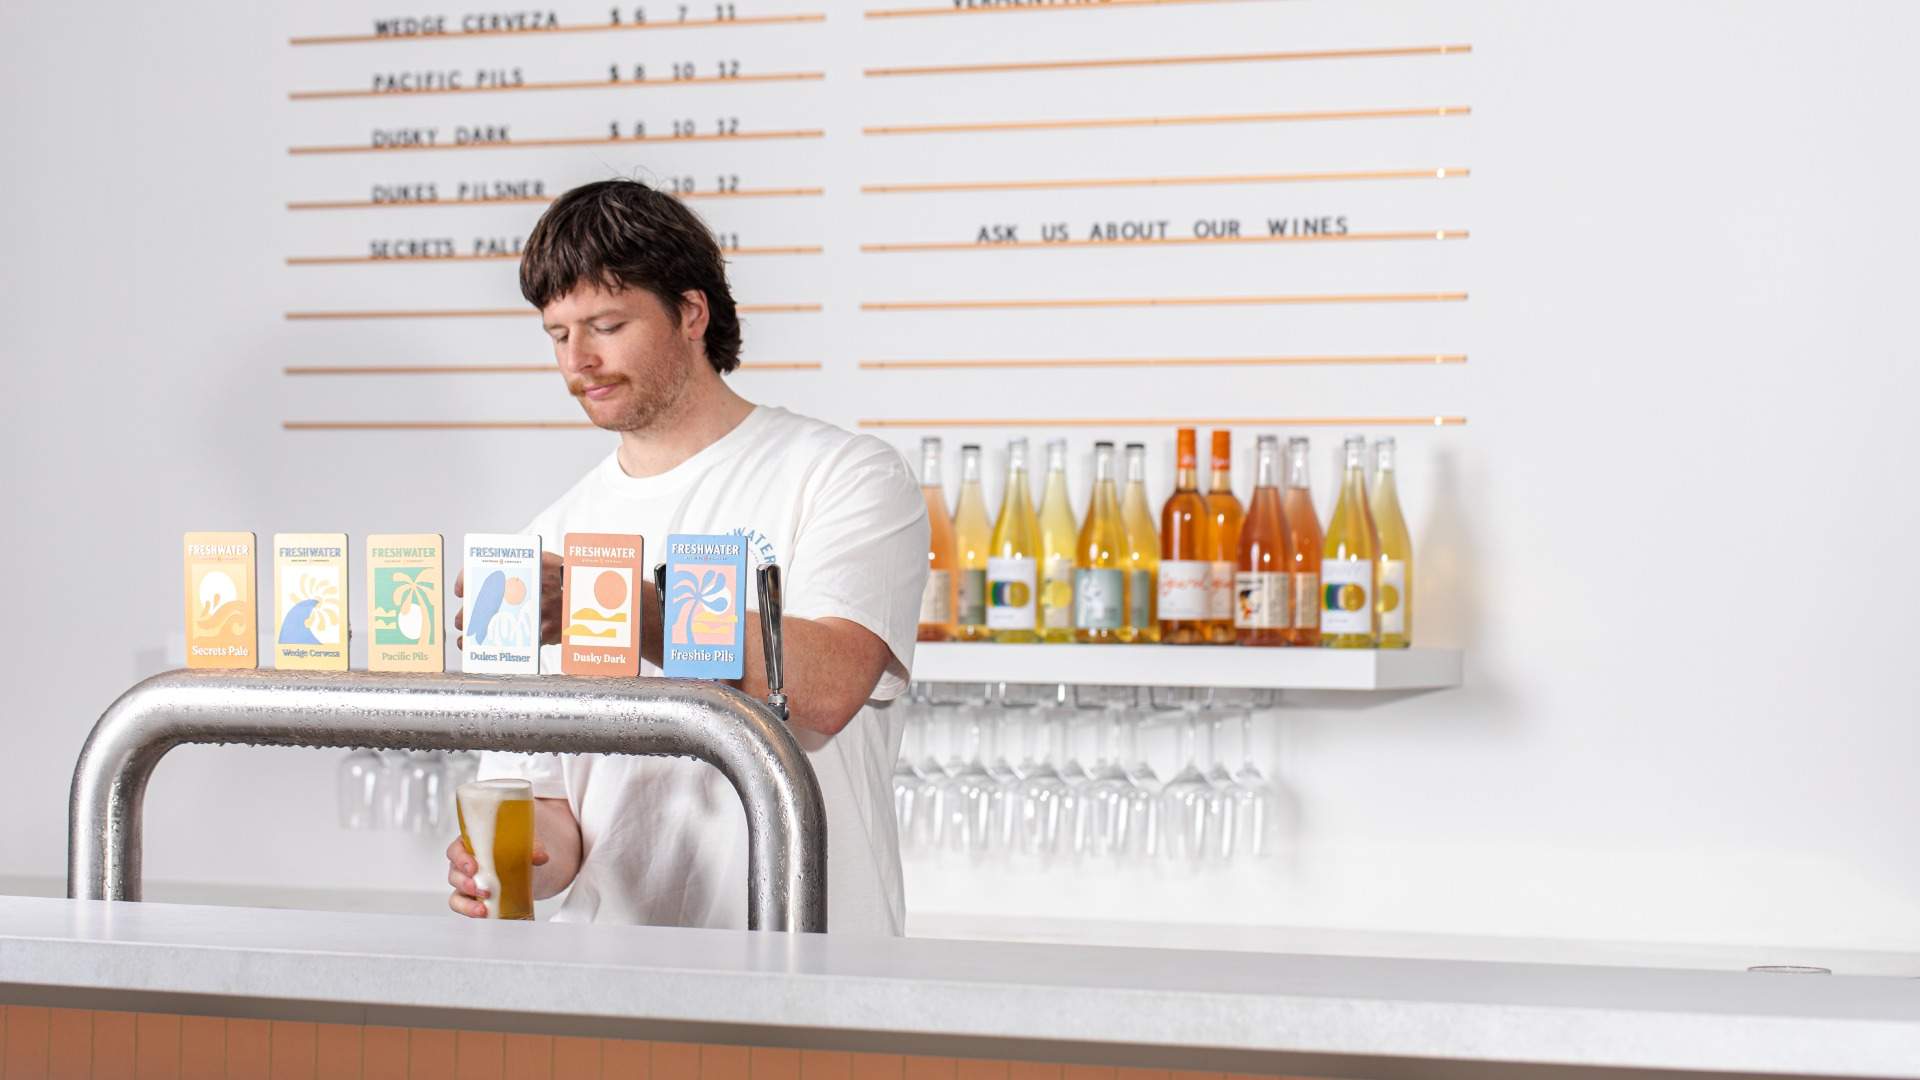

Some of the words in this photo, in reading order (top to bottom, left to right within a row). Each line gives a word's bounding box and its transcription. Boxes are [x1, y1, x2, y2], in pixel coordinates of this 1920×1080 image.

[374, 16, 446, 37] WEDGE
[462, 11, 558, 33] CERVEZA
[678, 4, 688, 23] 7
[715, 3, 737, 21] 11
[372, 71, 461, 93] PACIFIC
[475, 69, 524, 89] PILS
[672, 62, 696, 81] 10
[717, 60, 741, 79] 12
[370, 129, 438, 149] DUSKY
[454, 126, 511, 146] DARK
[672, 120, 696, 138] 10
[717, 118, 740, 136] 12
[370, 184, 439, 204] DUKES
[457, 180, 546, 201] PILSNER
[672, 177, 696, 194] 10
[717, 175, 741, 193] 12
[976, 225, 1019, 243] ASK
[1041, 223, 1069, 242] US
[1089, 221, 1170, 241] ABOUT
[1192, 219, 1241, 239] OUR
[1267, 217, 1349, 237] WINES
[369, 239, 456, 259] SECRETS
[473, 237, 522, 257] PALE
[188, 543, 250, 557] FRESHWATER
[569, 545, 636, 559] FRESHWATER
[671, 543, 740, 556] FRESHWATER
[725, 526, 777, 564] WATER
[279, 547, 342, 558] FRESHWATER
[371, 547, 437, 558] FRESHWATER
[470, 546, 535, 559] FRESHWATER
[191, 645, 227, 656] Secrets
[228, 646, 250, 657] Pale
[282, 648, 306, 659] Wedge
[308, 649, 341, 658] Cerveza
[381, 652, 410, 661] Pacific
[412, 651, 429, 661] Pils
[470, 651, 498, 662] Dukes
[499, 652, 532, 663] Pilsner
[671, 649, 711, 662] Freshie
[713, 650, 736, 663] Pils
[573, 652, 602, 665] Dusky
[603, 653, 627, 664] Dark
